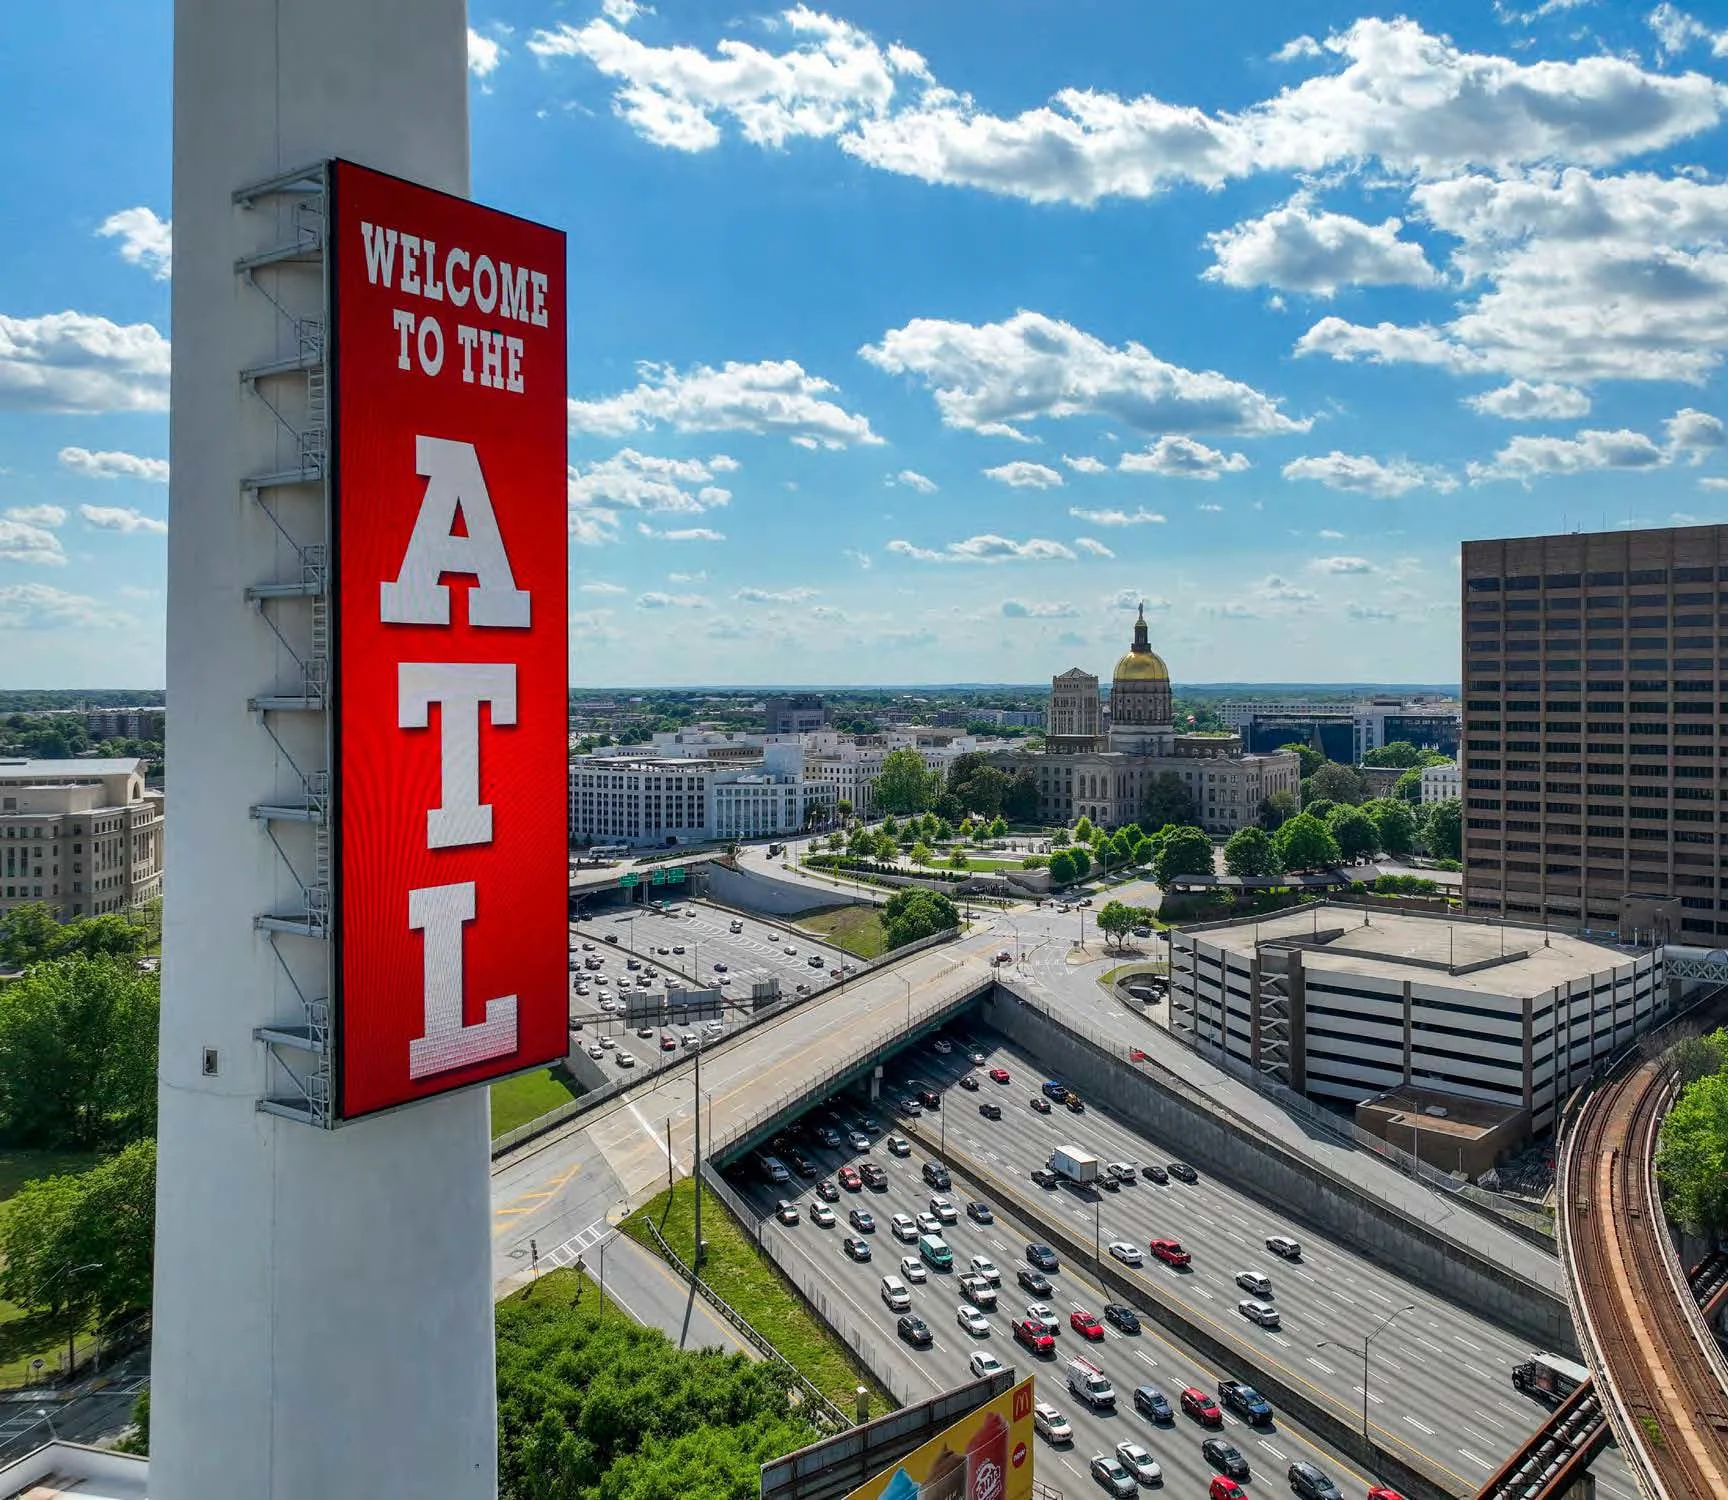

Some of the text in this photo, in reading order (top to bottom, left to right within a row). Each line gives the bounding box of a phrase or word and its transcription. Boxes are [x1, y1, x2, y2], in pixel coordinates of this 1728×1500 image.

[361, 221, 548, 328] WELCOME
[393, 309, 524, 394] TO THE
[380, 434, 531, 1079] ATL
